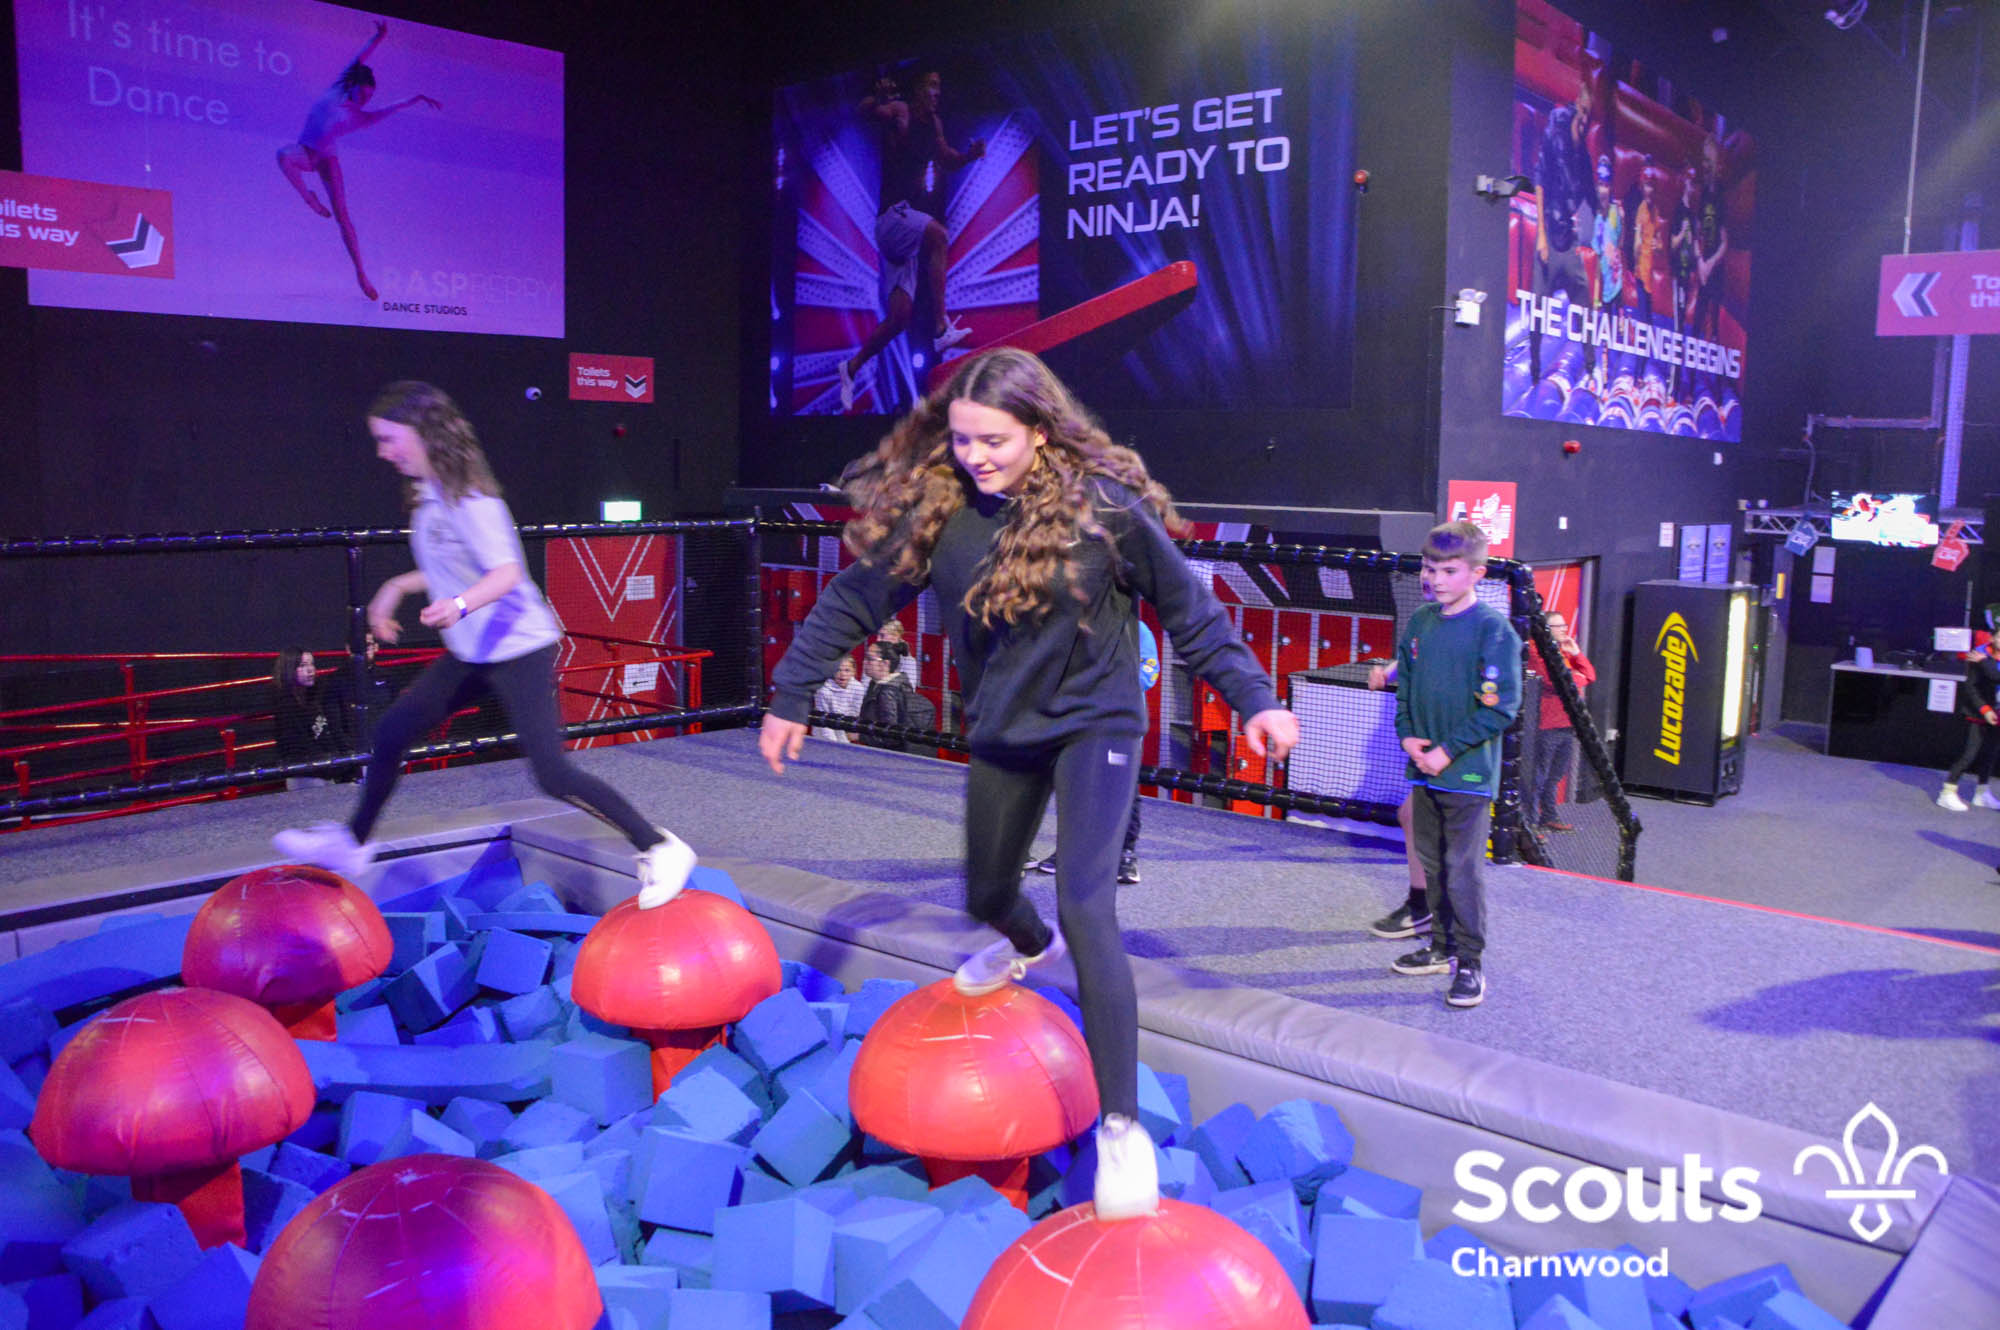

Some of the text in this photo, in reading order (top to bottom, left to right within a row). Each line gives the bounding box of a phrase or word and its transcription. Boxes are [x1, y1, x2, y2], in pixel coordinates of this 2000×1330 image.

[68, 0, 292, 76] It's time to
[88, 65, 229, 125] Dance
[1068, 87, 1283, 151] LET'S GET
[1067, 136, 1290, 195] READY TO
[0, 199, 58, 222] ilets
[27, 226, 79, 247] way
[1066, 194, 1200, 240] NINJA!
[383, 301, 468, 317] DANCE STUDIOS
[1516, 289, 1741, 379] THE CHALLENGE BEGINS
[576, 366, 611, 377] Toilets
[576, 376, 597, 387] this
[1653, 635, 1688, 766] Lucozade
